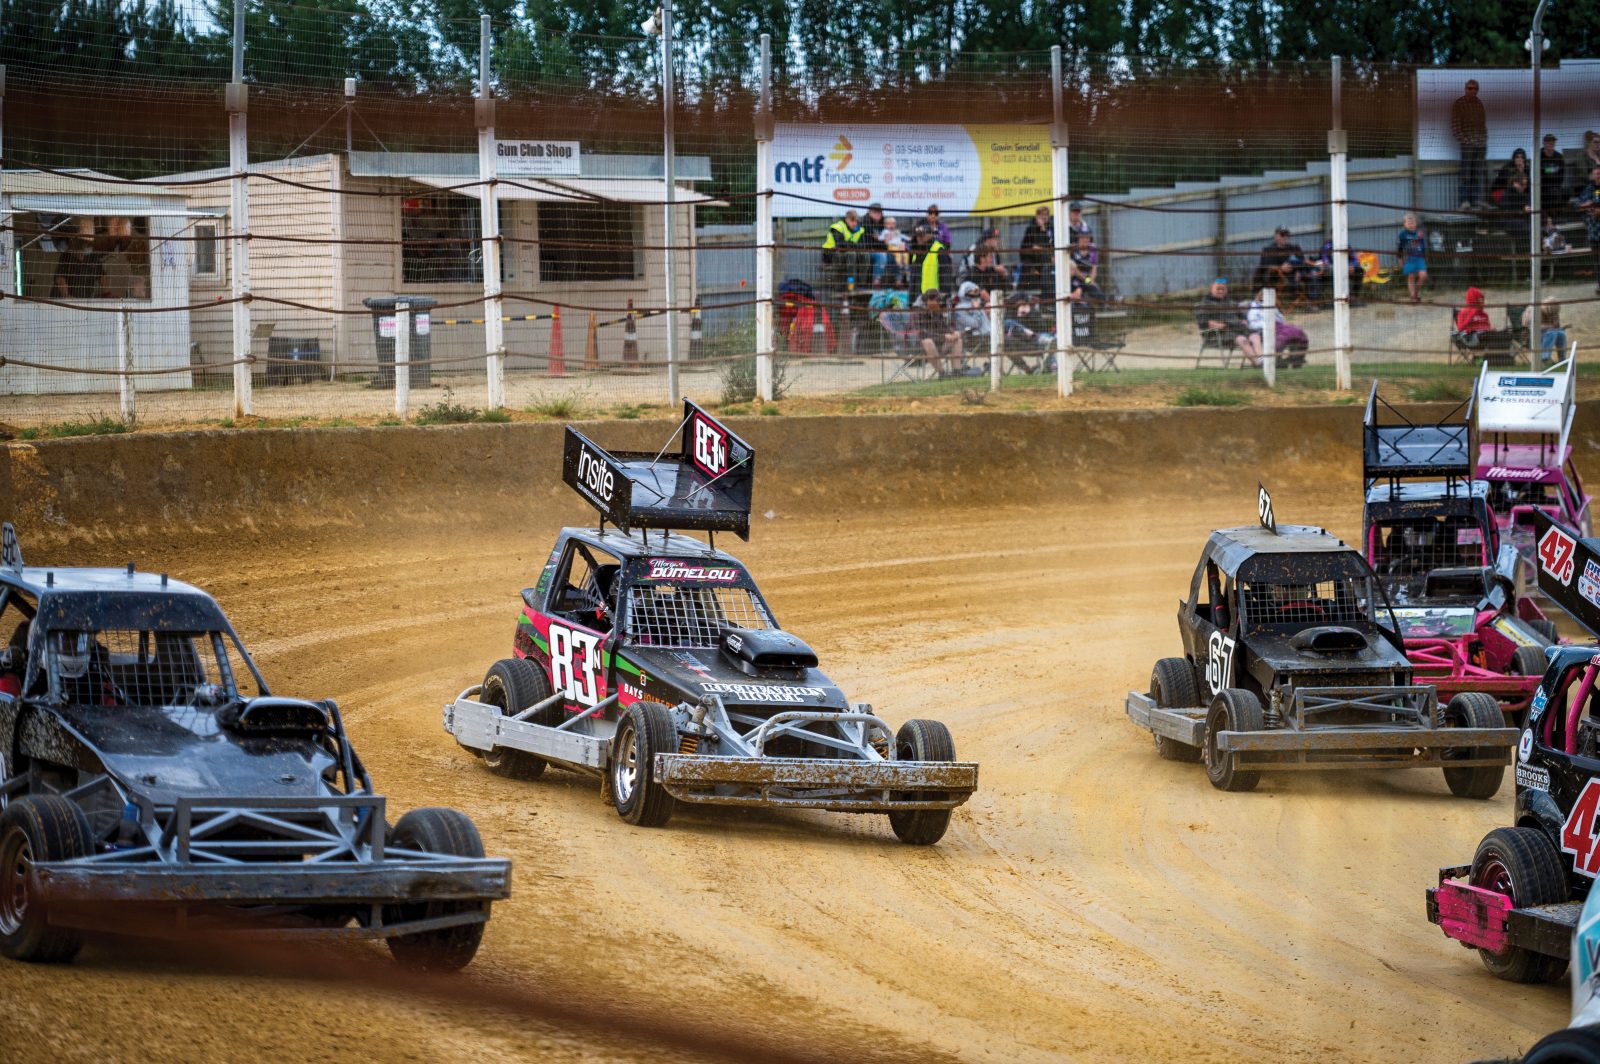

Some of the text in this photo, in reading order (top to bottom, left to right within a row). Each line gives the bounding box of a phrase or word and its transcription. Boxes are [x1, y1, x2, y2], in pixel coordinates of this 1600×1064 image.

[497, 143, 572, 159] Gun Club Shop
[775, 155, 871, 184] mtf finance
[937, 158, 960, 168] Road
[696, 418, 725, 474] 83N
[577, 443, 614, 502] insite
[1540, 530, 1574, 581] 47C
[651, 567, 736, 580] DUMELOW
[549, 624, 601, 706] 83N
[624, 683, 643, 700] BAYS
[700, 682, 827, 698] RECREATION
[735, 691, 805, 704] HOTEL
[1517, 768, 1549, 784] BROOKS
